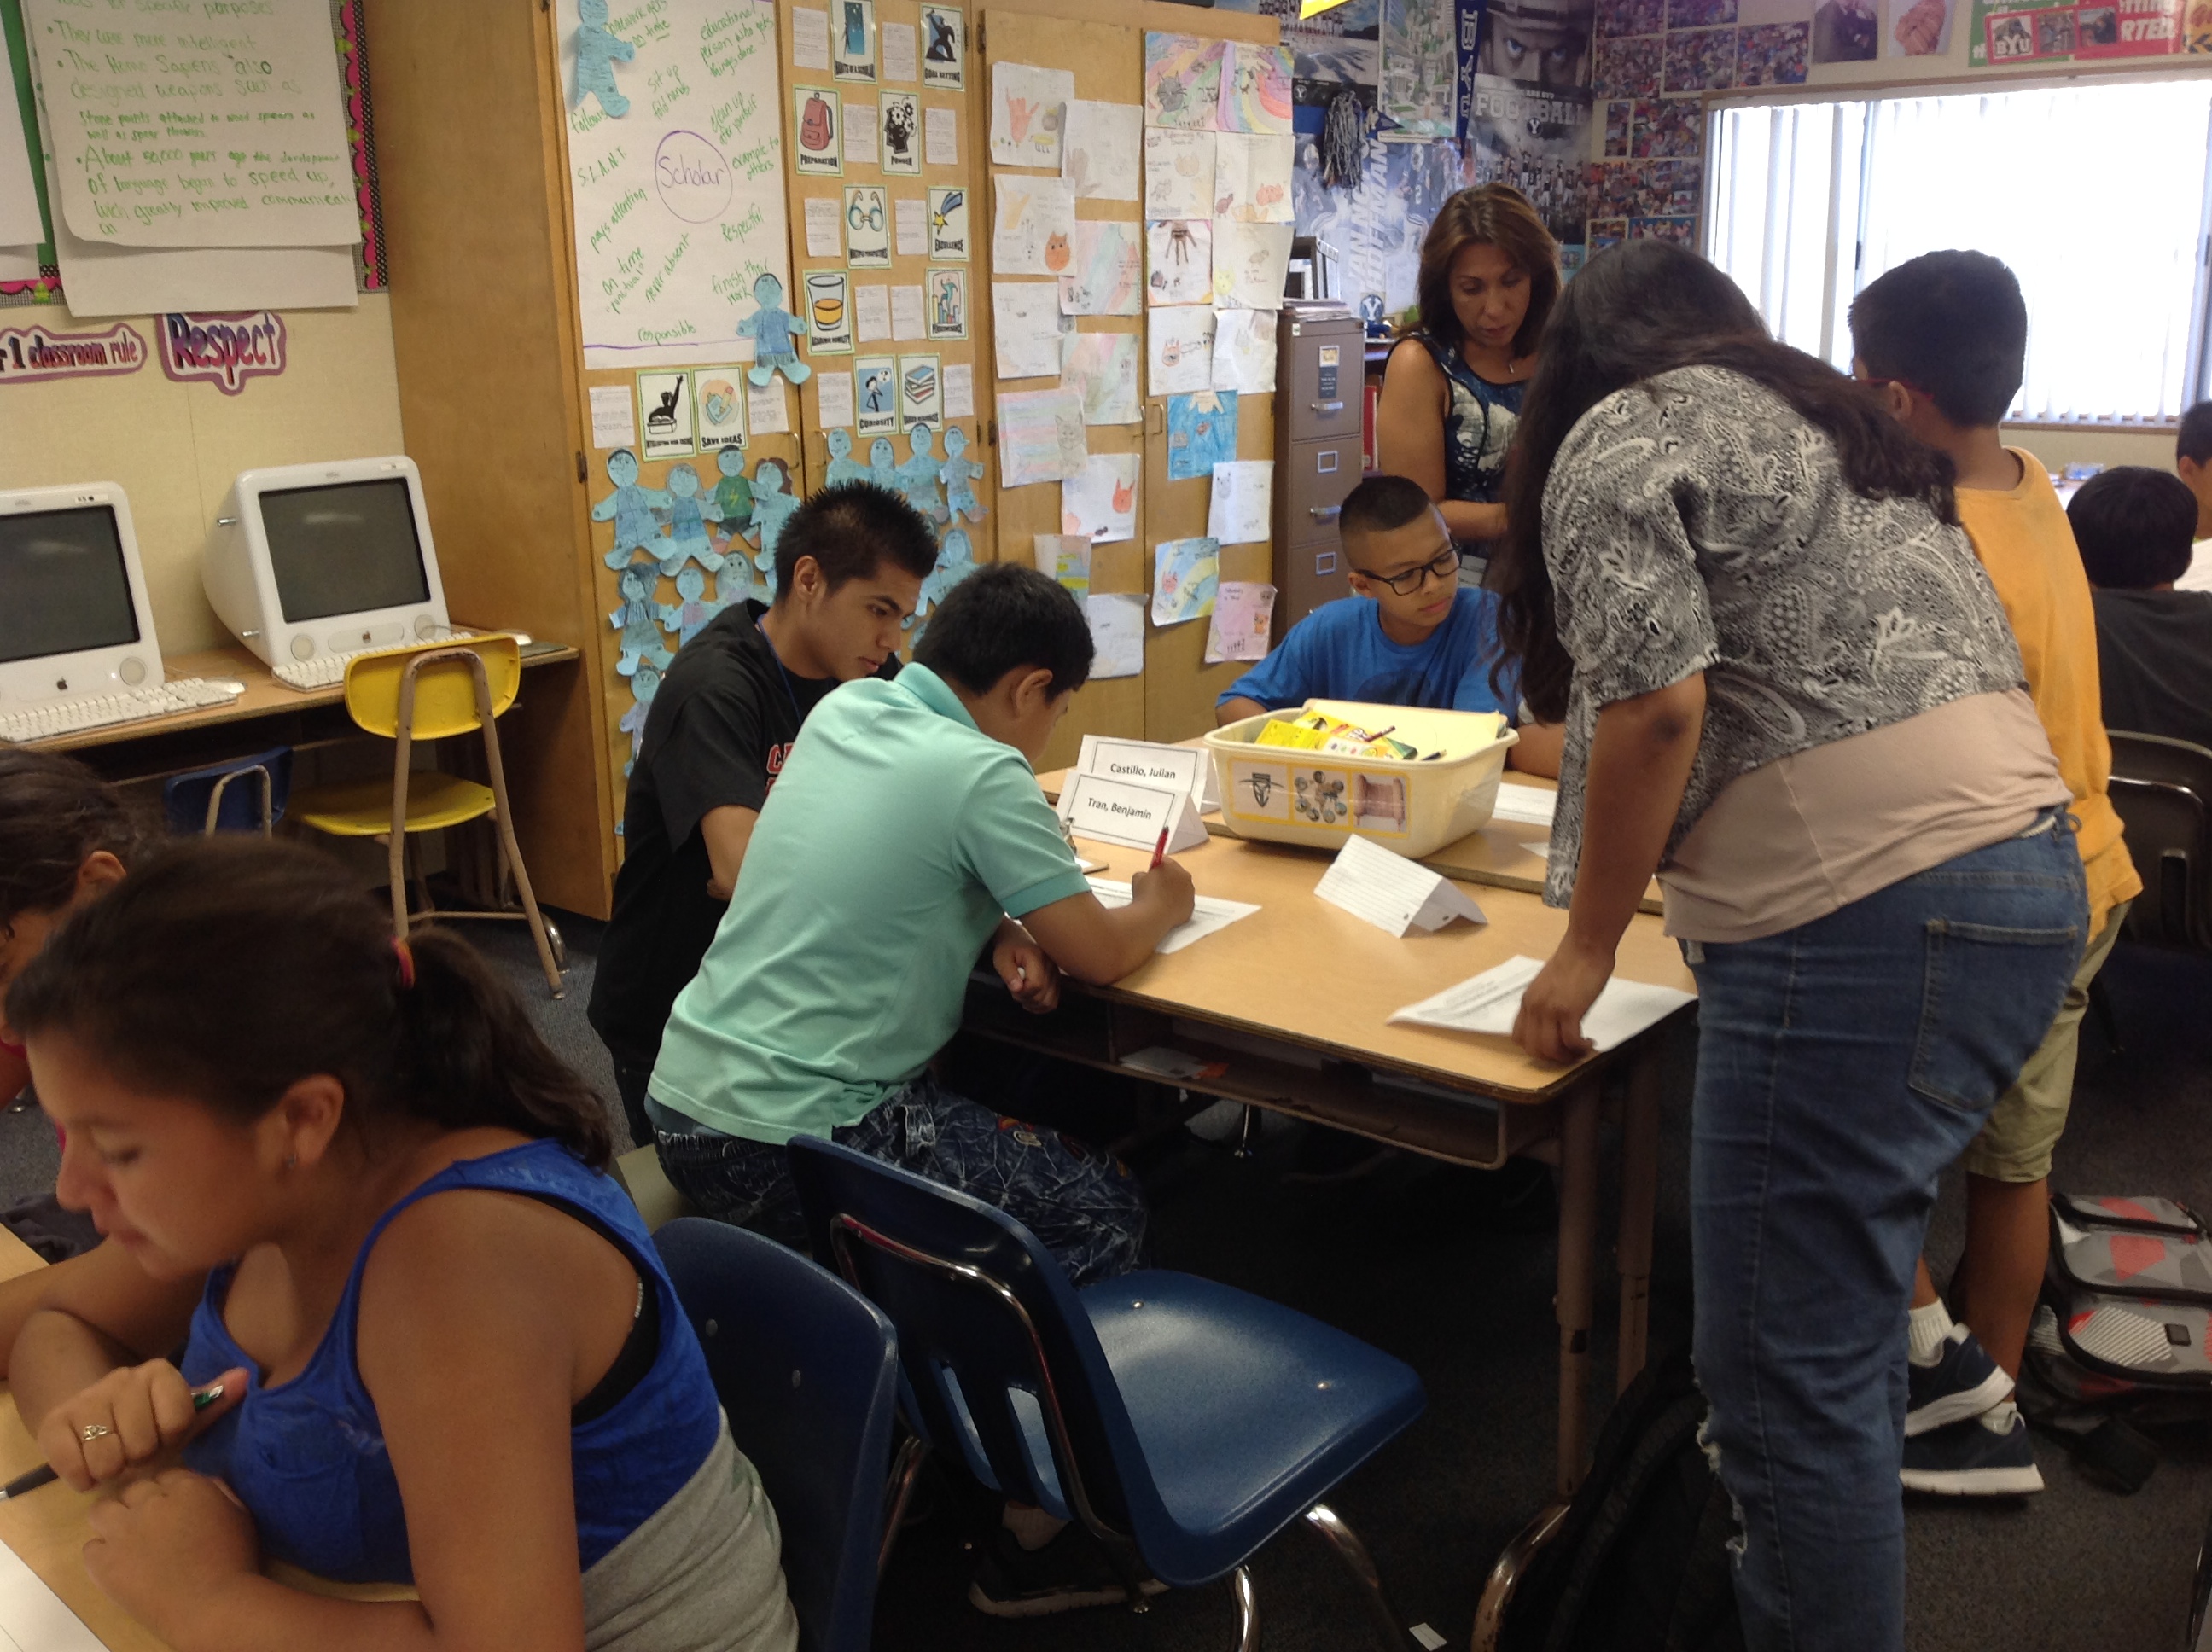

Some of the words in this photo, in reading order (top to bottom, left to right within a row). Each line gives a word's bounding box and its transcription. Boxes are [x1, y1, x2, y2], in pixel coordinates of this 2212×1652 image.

[700, 37, 733, 67] person
[1995, 34, 2031, 56] BYU
[62, 48, 100, 73] The
[658, 154, 725, 189] Scholar
[109, 331, 138, 365] rule
[168, 311, 277, 387] Respect
[859, 416, 894, 430] CURIOSITY
[1110, 762, 1147, 777] Castillo,
[1148, 767, 1177, 780] Julian
[1087, 797, 1109, 811] Tran,
[1110, 802, 1153, 820] Benjamin
